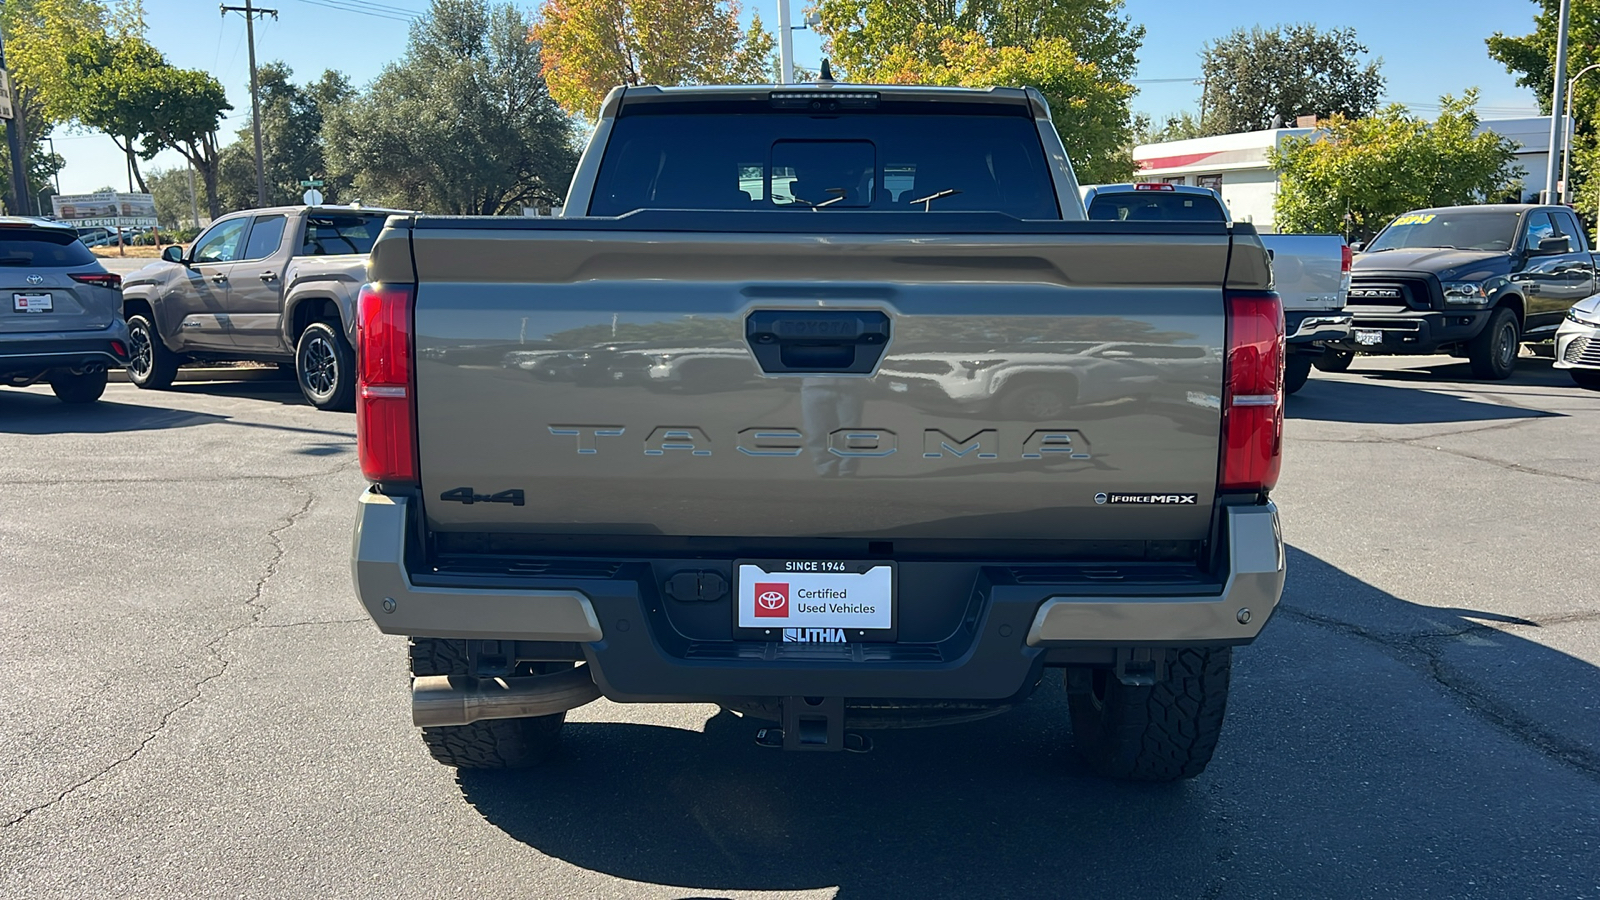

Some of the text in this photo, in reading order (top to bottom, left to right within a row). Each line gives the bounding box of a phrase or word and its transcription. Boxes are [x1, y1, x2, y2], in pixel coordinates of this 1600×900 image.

[784, 321, 852, 334] TOYOTA
[548, 424, 1092, 458] TACOMA
[785, 561, 846, 571] SINCE 1946
[797, 588, 847, 599] Certified
[797, 602, 876, 614] Used Vehicles
[797, 628, 847, 643] LITHIA
